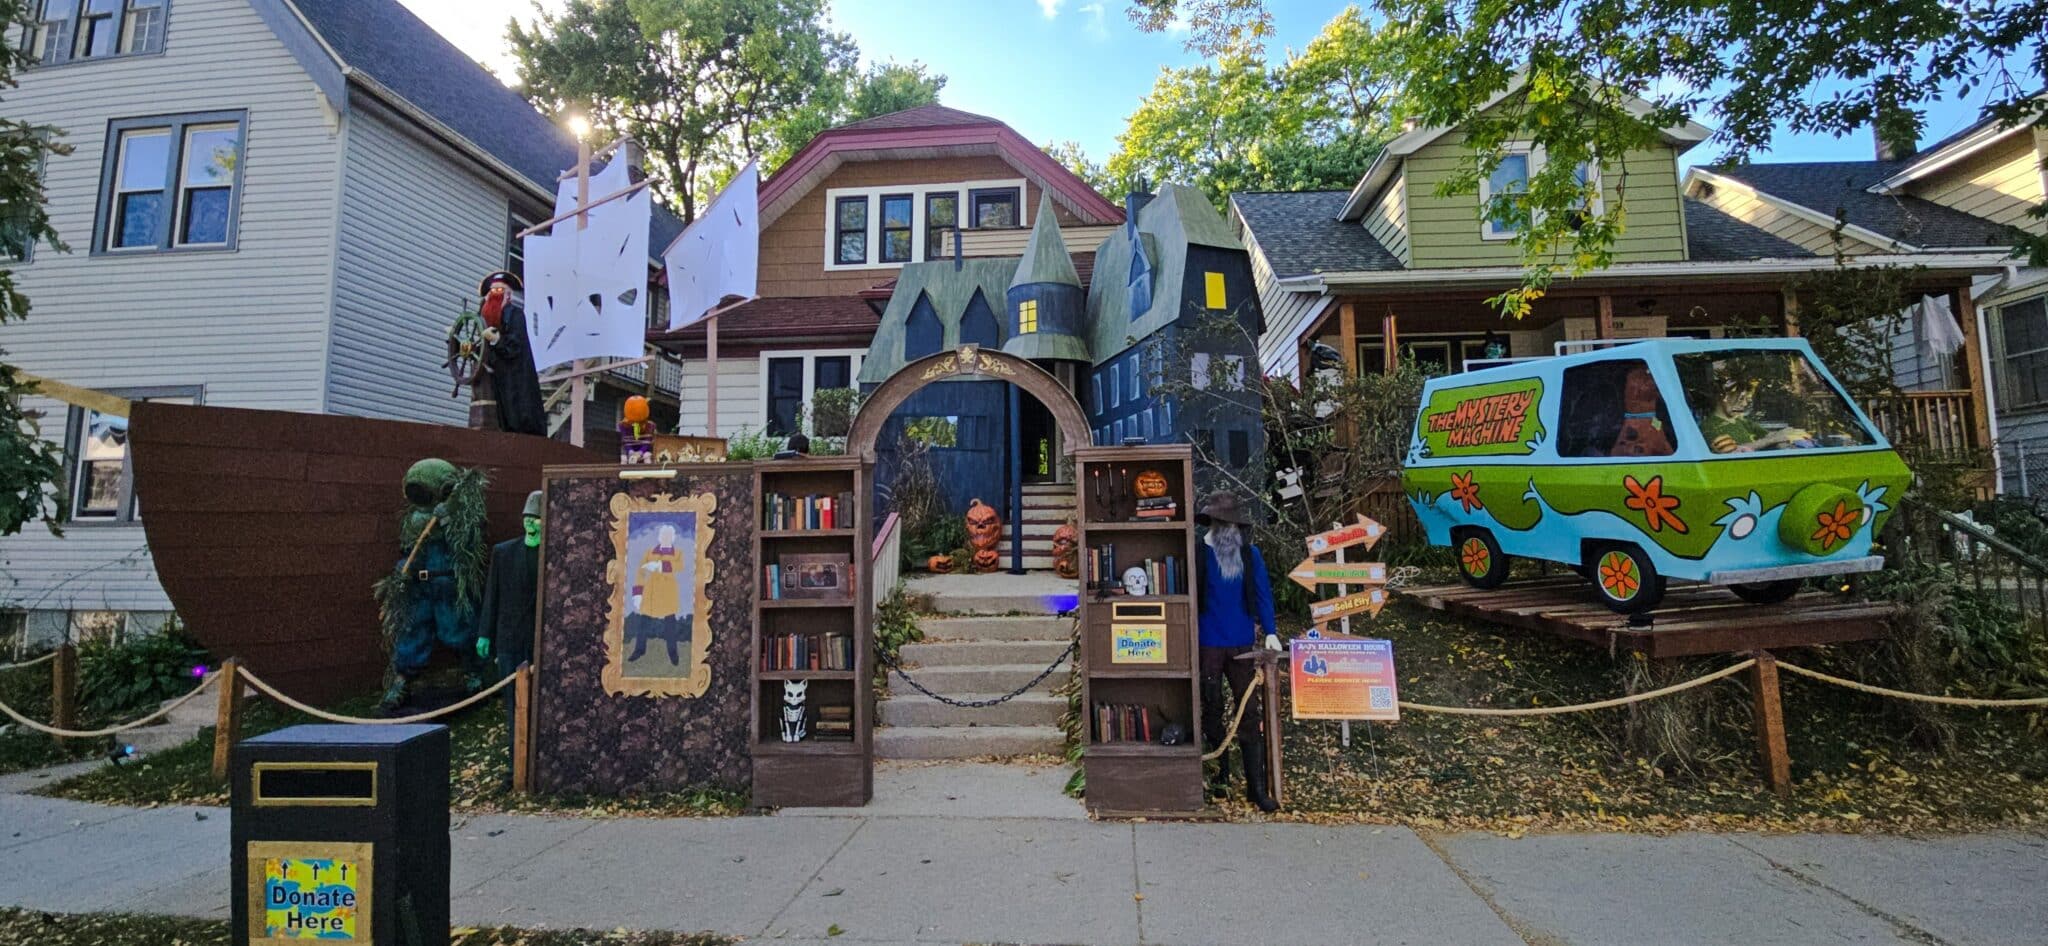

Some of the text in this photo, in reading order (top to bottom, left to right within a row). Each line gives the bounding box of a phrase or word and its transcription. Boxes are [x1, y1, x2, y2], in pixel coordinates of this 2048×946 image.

[1428, 389, 1536, 432] THE MYSTERY
[1447, 415, 1526, 447] MACHINE
[1334, 601, 1353, 612] Gold
[1353, 597, 1370, 607] City
[1121, 639, 1156, 648] Donate
[272, 886, 356, 907] Donate
[287, 912, 344, 930] Here
